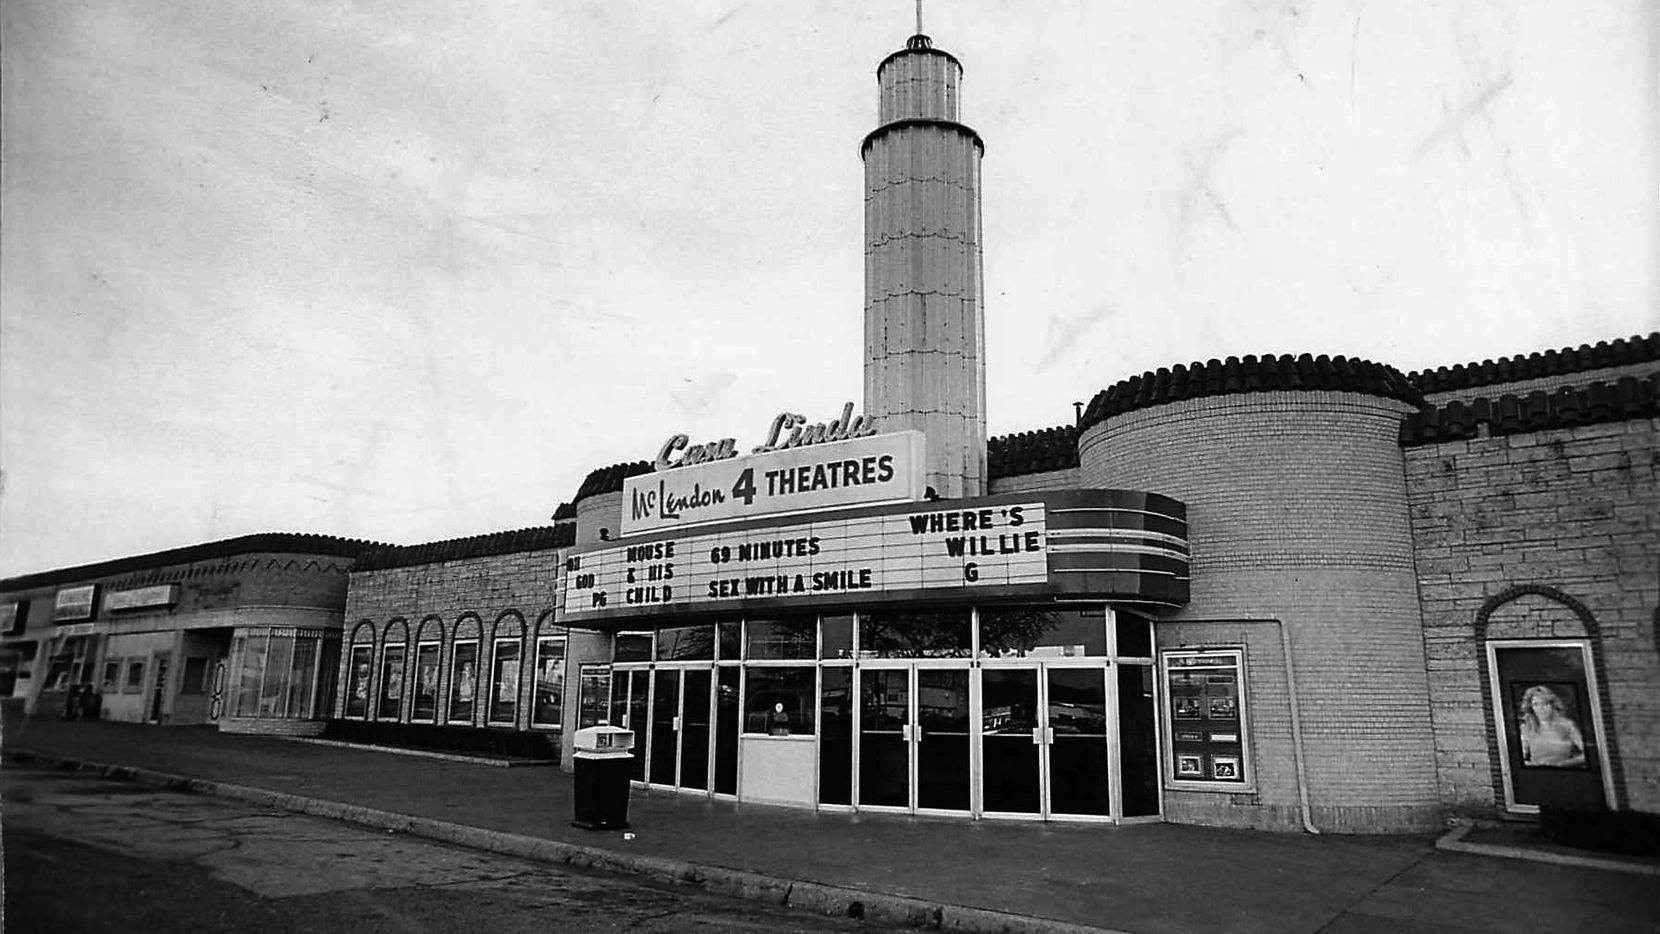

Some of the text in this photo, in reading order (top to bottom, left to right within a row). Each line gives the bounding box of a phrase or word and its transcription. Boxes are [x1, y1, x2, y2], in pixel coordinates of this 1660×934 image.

[752, 402, 877, 453] Linda
[632, 455, 893, 520] McLendon 4 THEATRES
[909, 506, 1024, 534] WHERE'S
[627, 541, 675, 563] MOUSE
[711, 537, 820, 564] 69 MINUTES
[945, 531, 1039, 557] WILLIE
[576, 574, 594, 589] GOD
[649, 563, 674, 582] HIS
[708, 569, 872, 598] SEX WITH A SMILE
[964, 562, 979, 582] G
[592, 591, 606, 608] PG
[626, 585, 672, 604] CHILD
